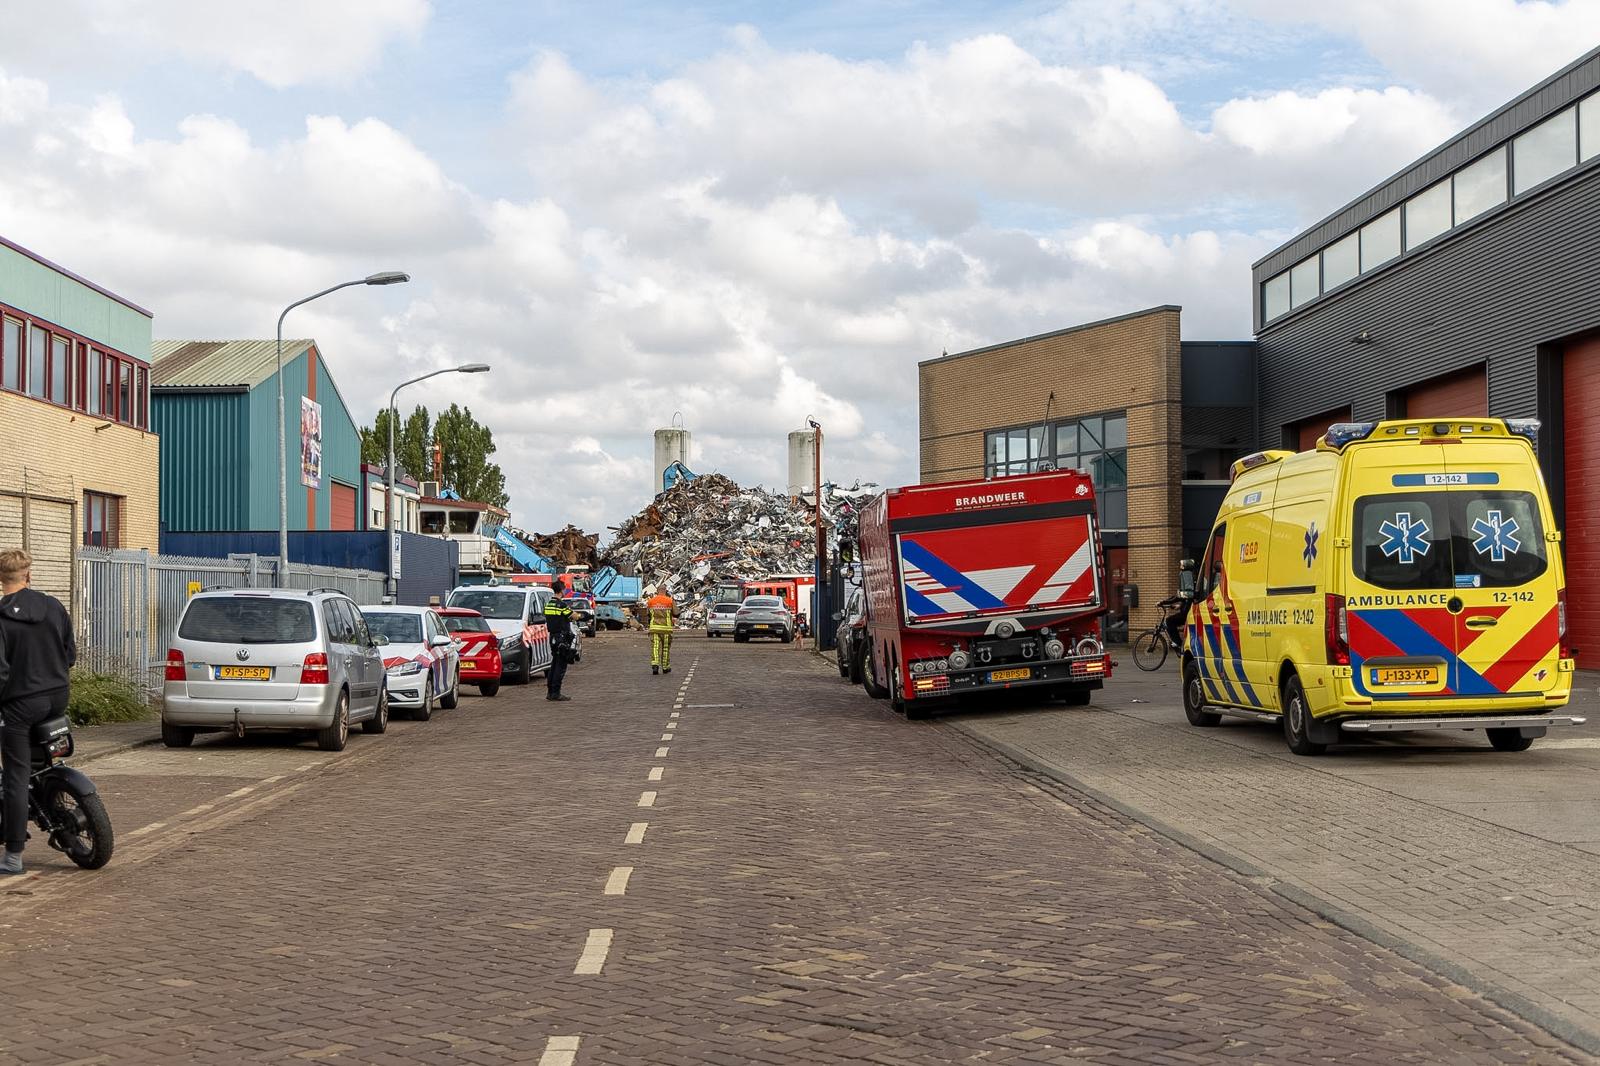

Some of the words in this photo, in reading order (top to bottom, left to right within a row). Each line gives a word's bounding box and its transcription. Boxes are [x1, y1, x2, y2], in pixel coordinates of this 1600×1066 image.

[1432, 475, 1462, 483] 12-142
[955, 492, 1025, 506] BRANDWEER
[1347, 594, 1447, 606] AMBULANCE
[1492, 592, 1534, 602] 12-142
[1246, 610, 1288, 625] AMBULANCE
[1292, 609, 1315, 625] 12-142
[225, 668, 266, 677] 91-SP-SP
[1383, 670, 1430, 681] J-133-XP
